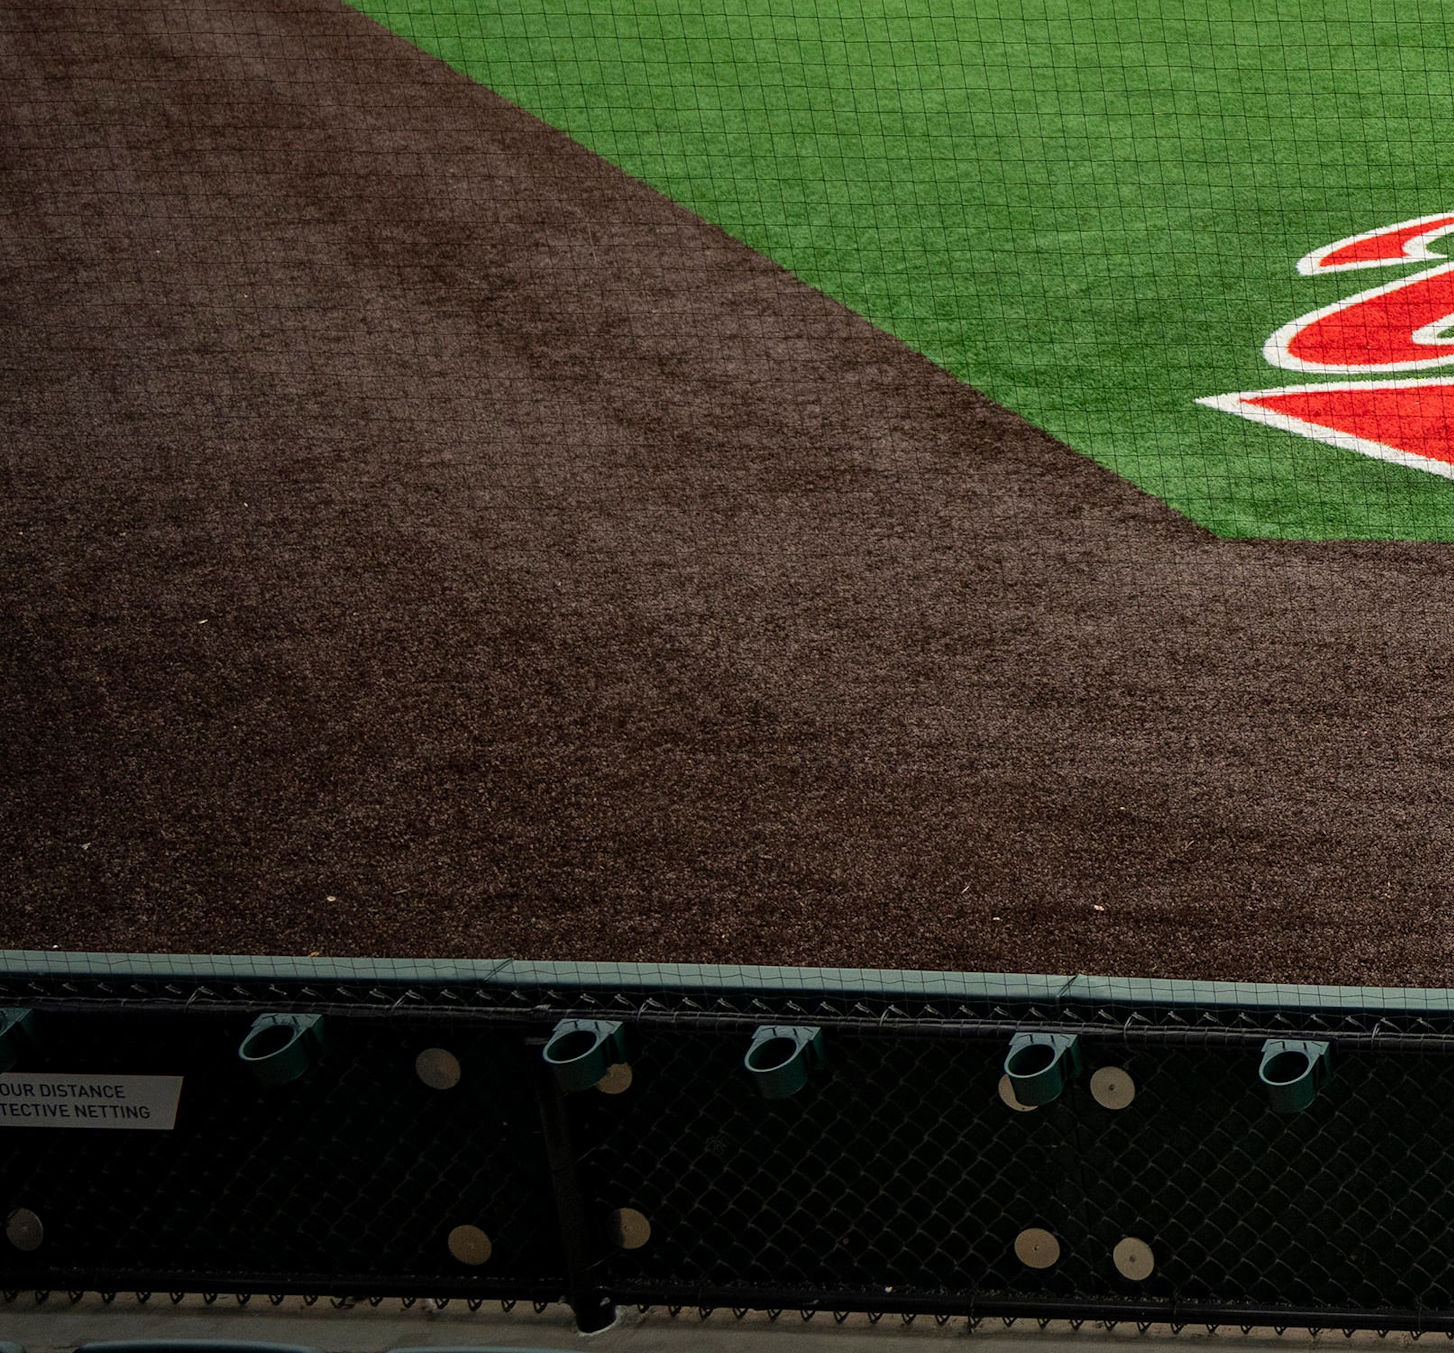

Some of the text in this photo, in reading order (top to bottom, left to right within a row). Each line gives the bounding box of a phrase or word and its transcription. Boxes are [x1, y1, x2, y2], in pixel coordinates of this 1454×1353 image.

[0, 1083, 126, 1099] OUR DISTANCE
[0, 1103, 151, 1119] TECTIVE NETTING
